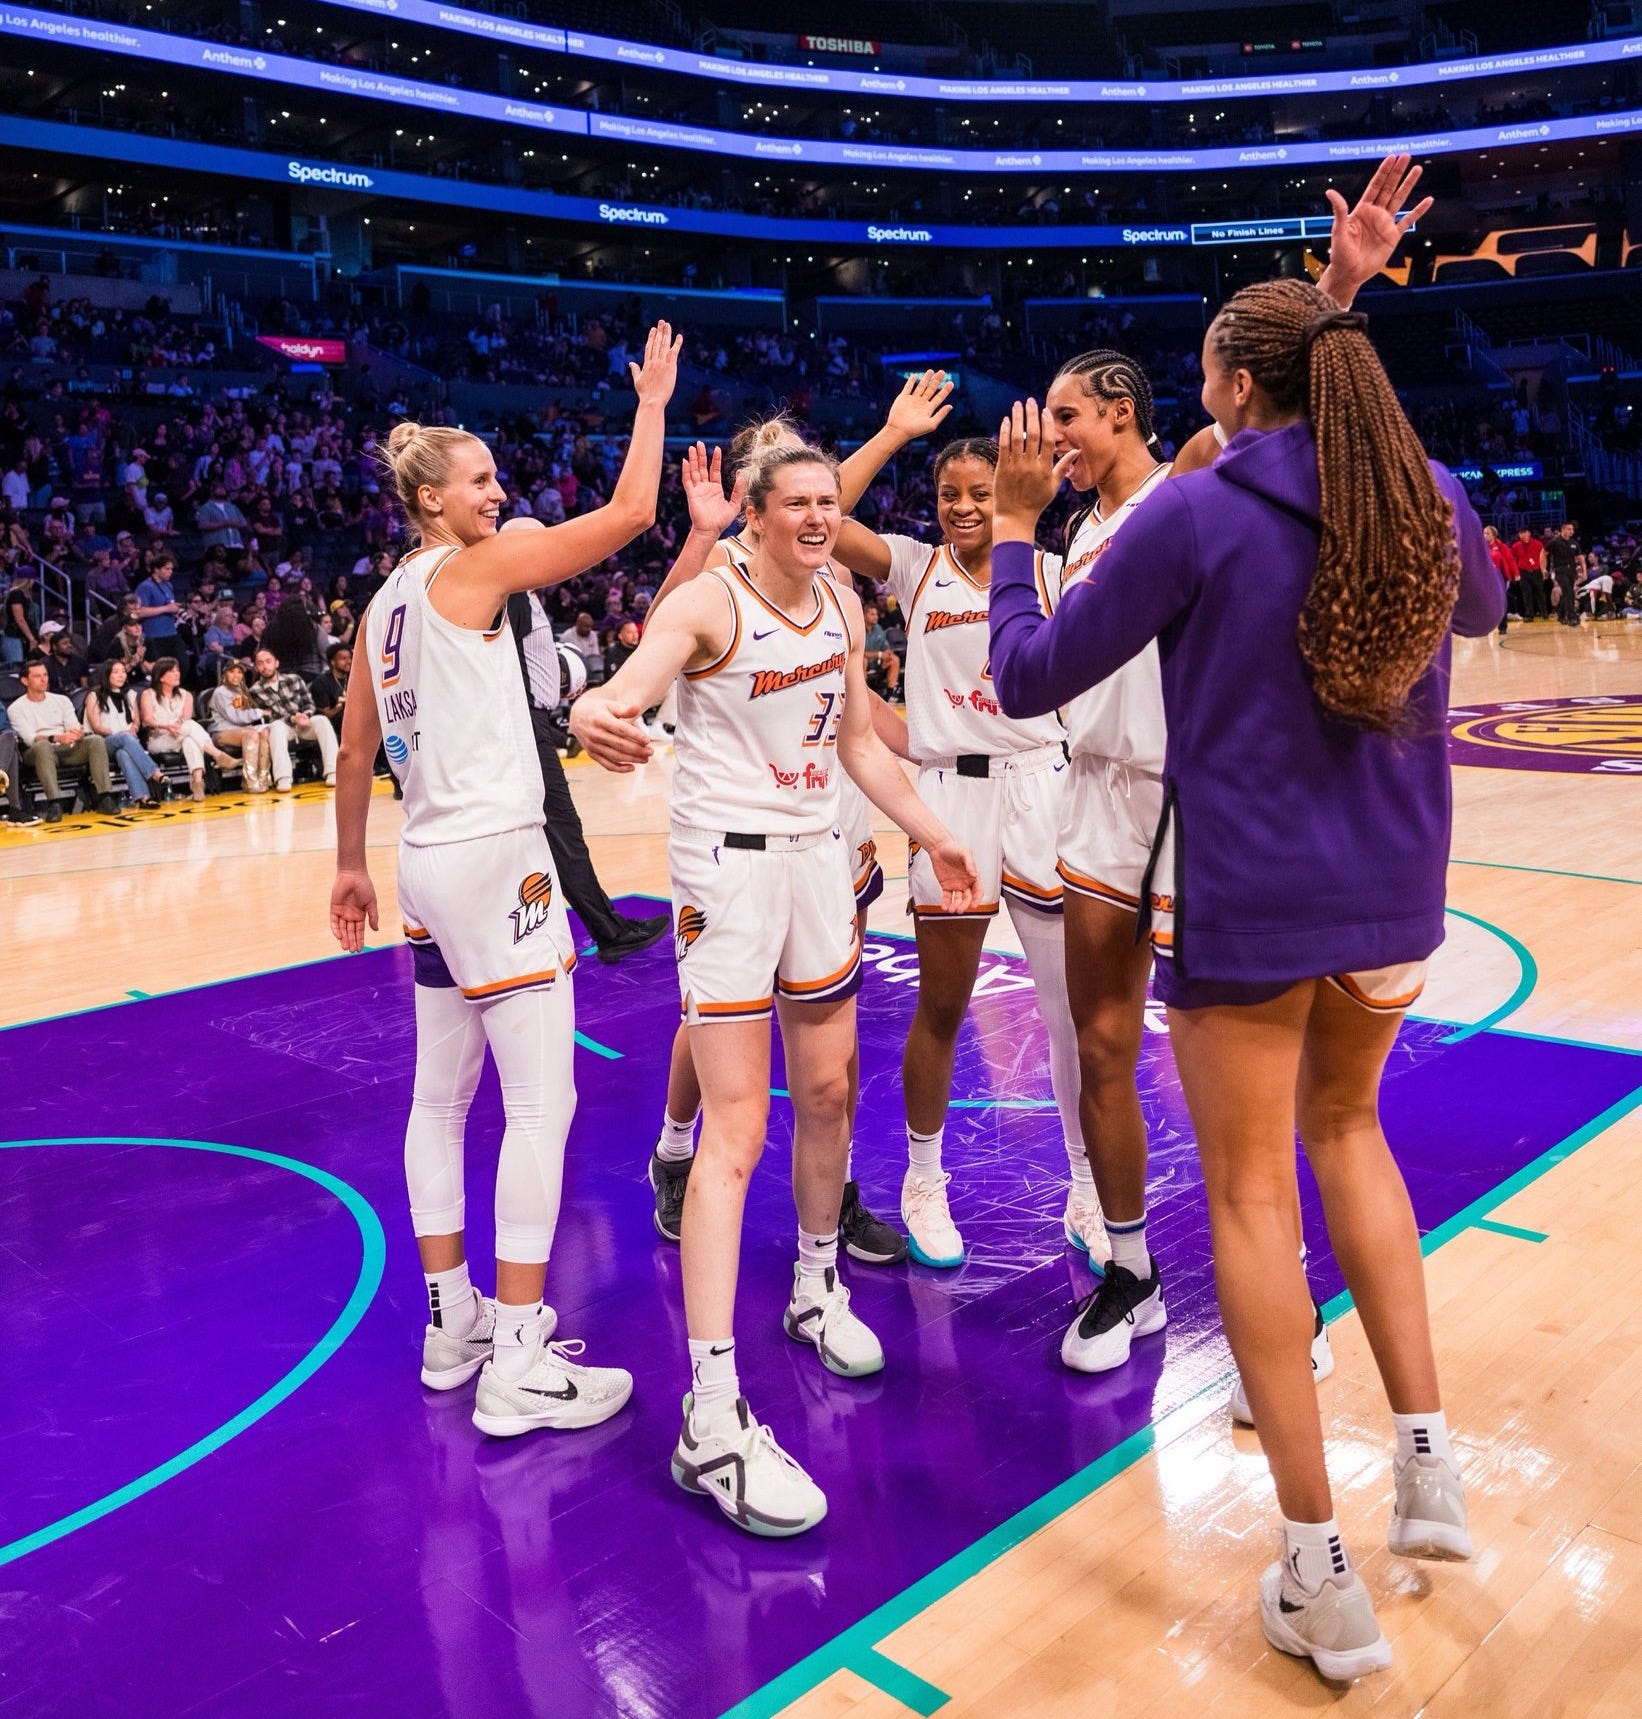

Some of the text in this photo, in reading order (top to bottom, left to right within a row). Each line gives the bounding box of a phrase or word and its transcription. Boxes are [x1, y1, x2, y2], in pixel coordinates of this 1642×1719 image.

[6, 14, 27, 27] Los
[30, 18, 80, 37] Angeles
[806, 36, 874, 55] TOSHIBA
[1622, 44, 1642, 54] Ant
[202, 49, 253, 68] Anthem
[617, 47, 654, 62] Anthem
[860, 78, 897, 90] Anthem
[1351, 75, 1388, 85] Anthem
[1101, 87, 1137, 96] Anthem
[505, 105, 543, 121] Anthem
[1498, 129, 1538, 141] Anthem
[755, 142, 792, 154] Anthem
[995, 156, 1032, 166] Anthem
[1239, 151, 1277, 161] Anthem
[288, 161, 369, 188] Spectrum
[599, 203, 664, 225] Spectrum
[867, 226, 929, 244] Spectrum
[1123, 229, 1184, 244] Spectrum
[1211, 226, 1284, 239] No Finish Lines
[1496, 466, 1534, 478] XPRESS
[924, 610, 990, 635] Merc
[381, 603, 407, 689] 9
[748, 650, 846, 701] Mercury
